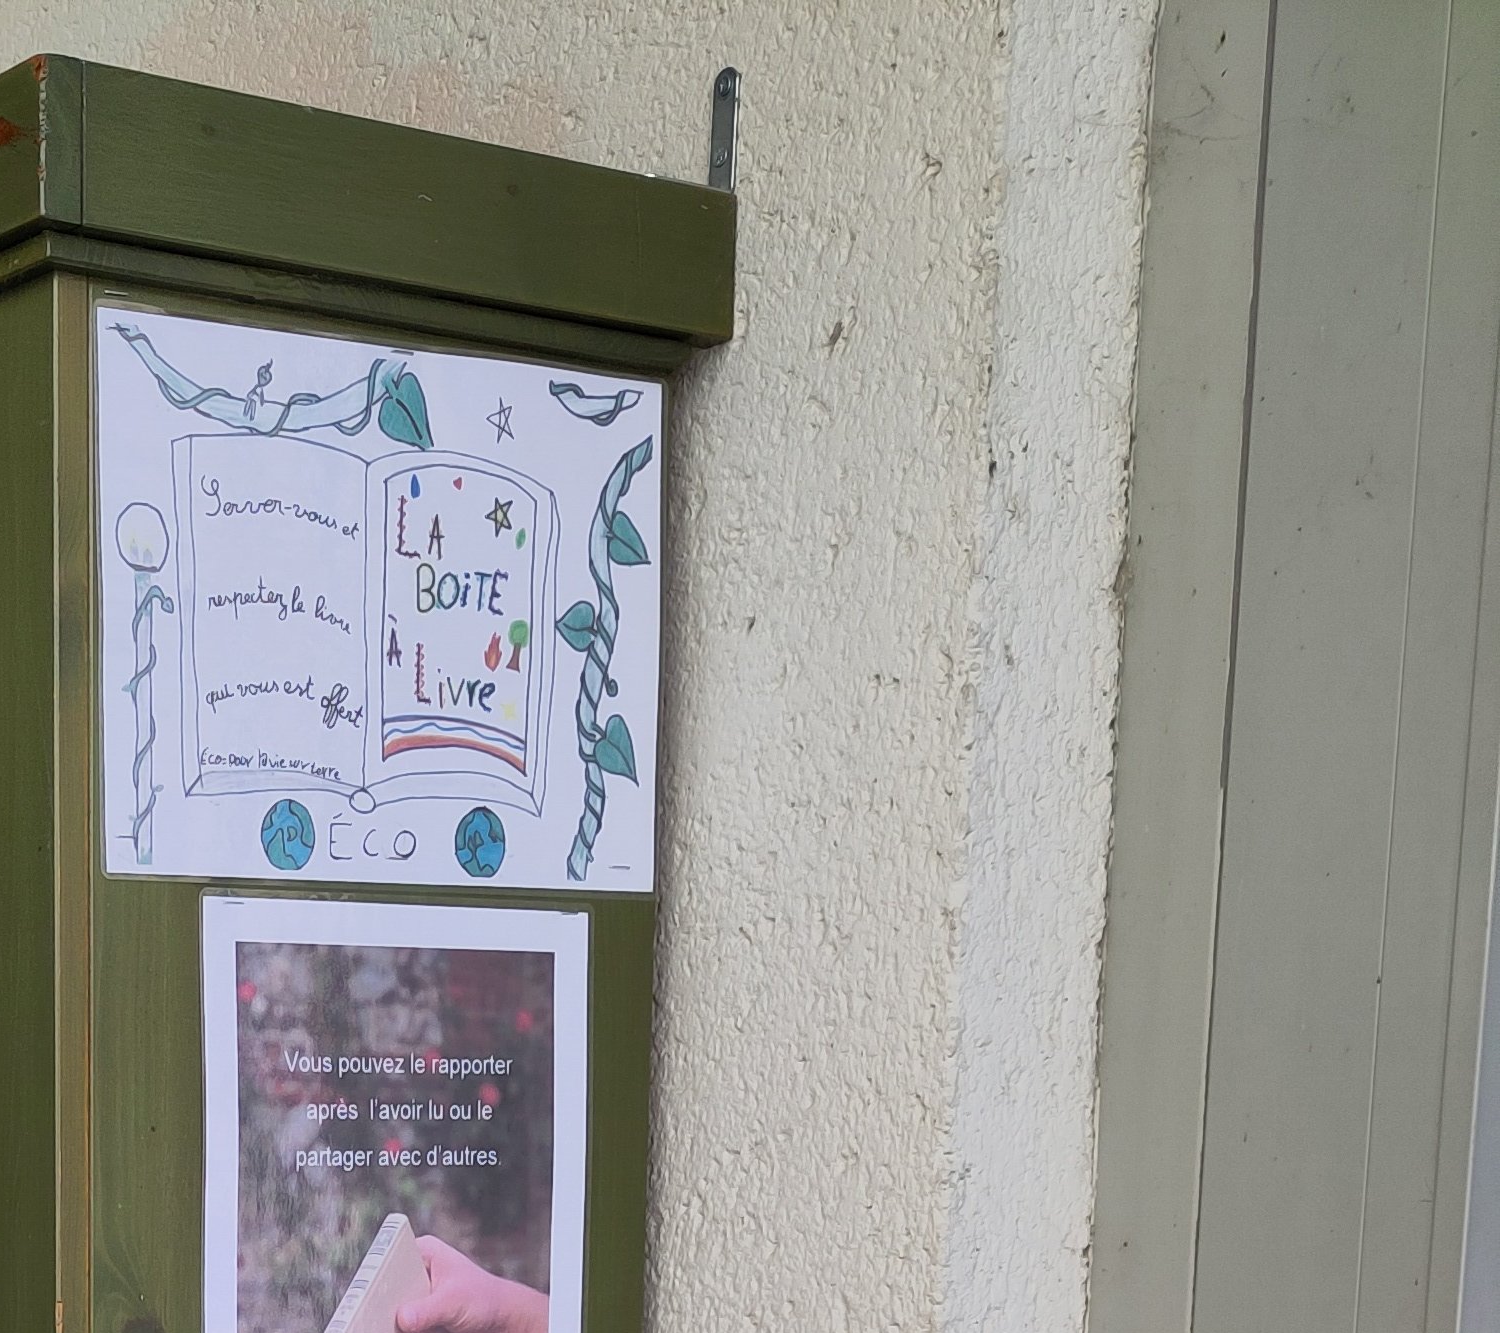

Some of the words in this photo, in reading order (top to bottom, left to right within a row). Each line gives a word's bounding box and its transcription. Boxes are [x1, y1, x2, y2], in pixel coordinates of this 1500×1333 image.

[342, 523, 359, 540] et
[396, 495, 444, 560] LA
[208, 575, 287, 621] respectez
[292, 586, 305, 613] le
[315, 595, 351, 634] livre
[237, 680, 279, 696] vous
[284, 675, 314, 700] est
[321, 683, 363, 729] offert
[284, 1050, 332, 1073] Vous
[338, 1057, 405, 1077] pouvez
[410, 1052, 426, 1074] le
[431, 1055, 512, 1079] rapporter
[306, 1098, 358, 1124] après
[370, 1099, 423, 1120] l'avoir
[429, 1100, 444, 1120] lu
[450, 1104, 471, 1120] ou
[478, 1099, 492, 1120] le
[295, 1149, 373, 1172] partager
[378, 1150, 421, 1166] avec
[426, 1146, 501, 1166] d'autres.
